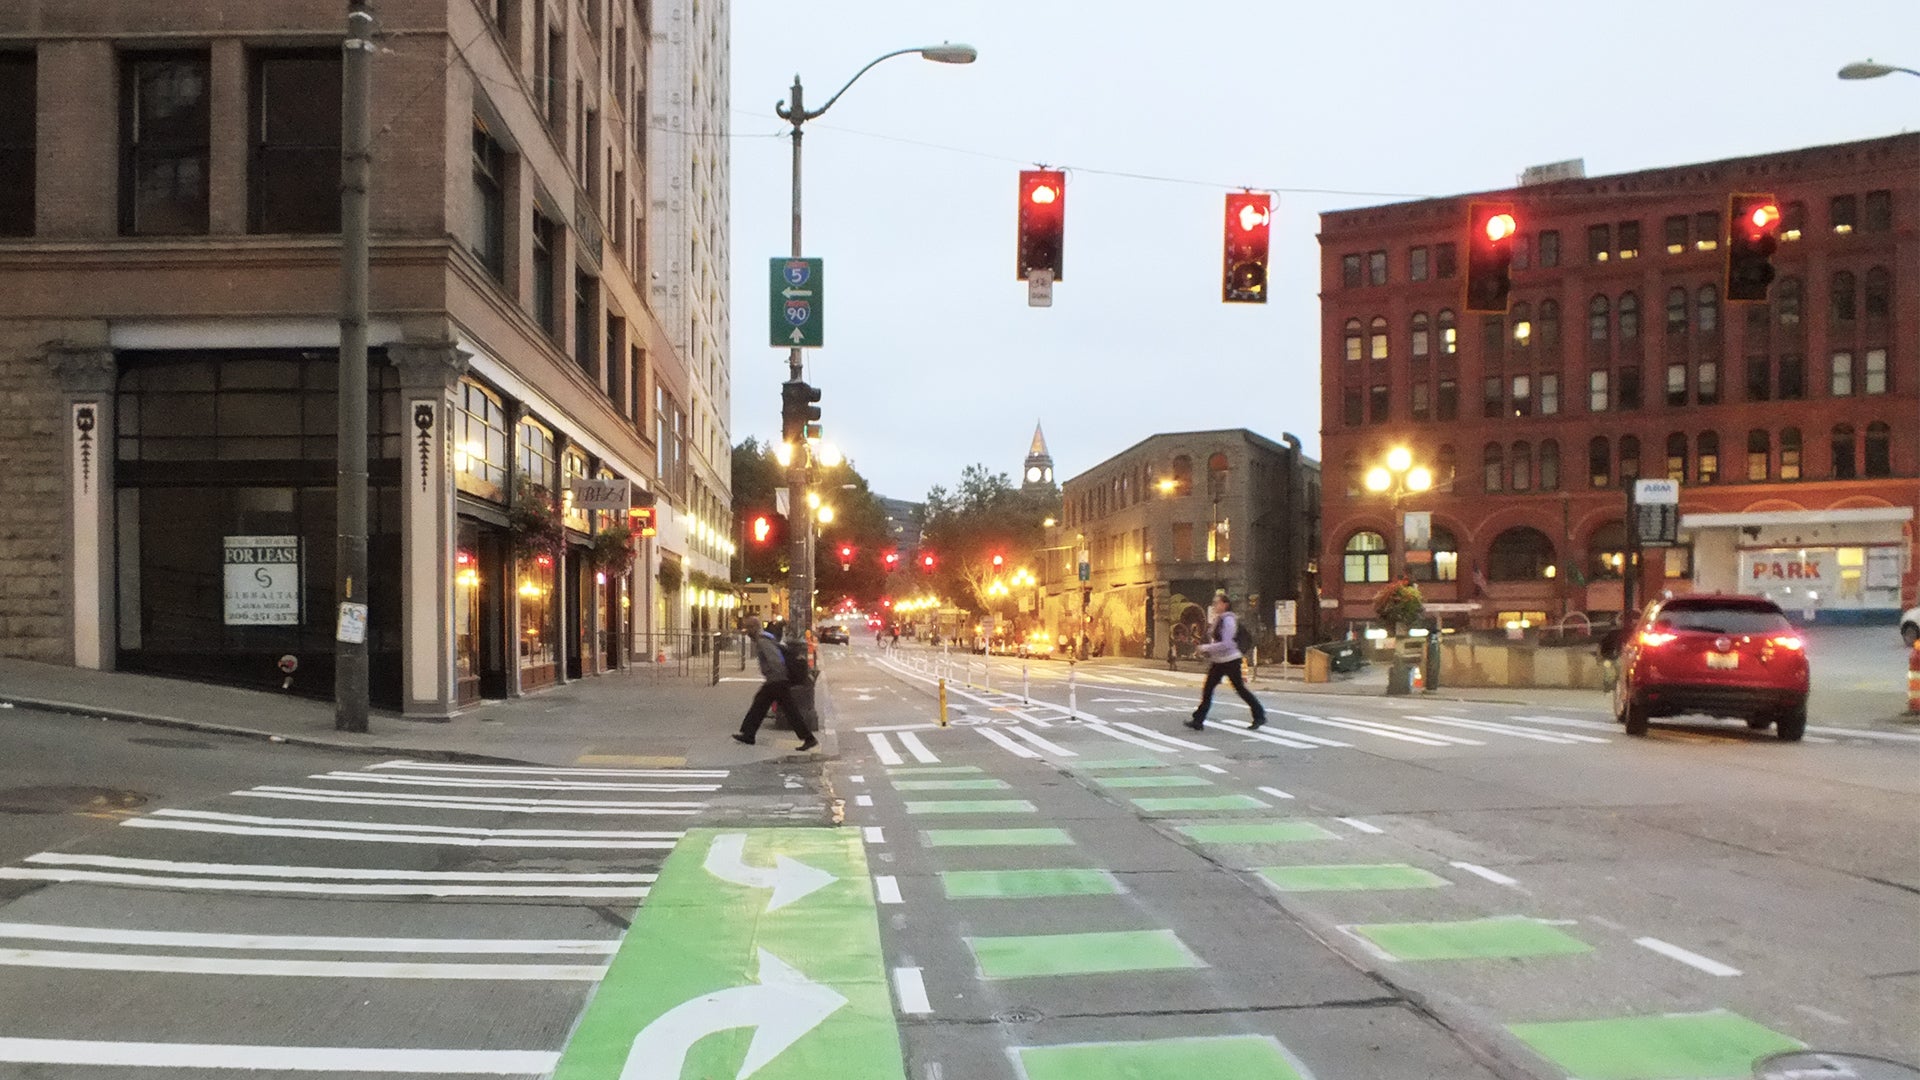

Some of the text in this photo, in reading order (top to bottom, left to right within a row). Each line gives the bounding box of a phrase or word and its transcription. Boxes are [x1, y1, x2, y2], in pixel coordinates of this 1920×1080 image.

[791, 268, 802, 283] 5
[787, 307, 806, 321] 90
[576, 486, 626, 502] IBIZA
[225, 548, 254, 563] FOR
[1753, 561, 1821, 579] PARK
